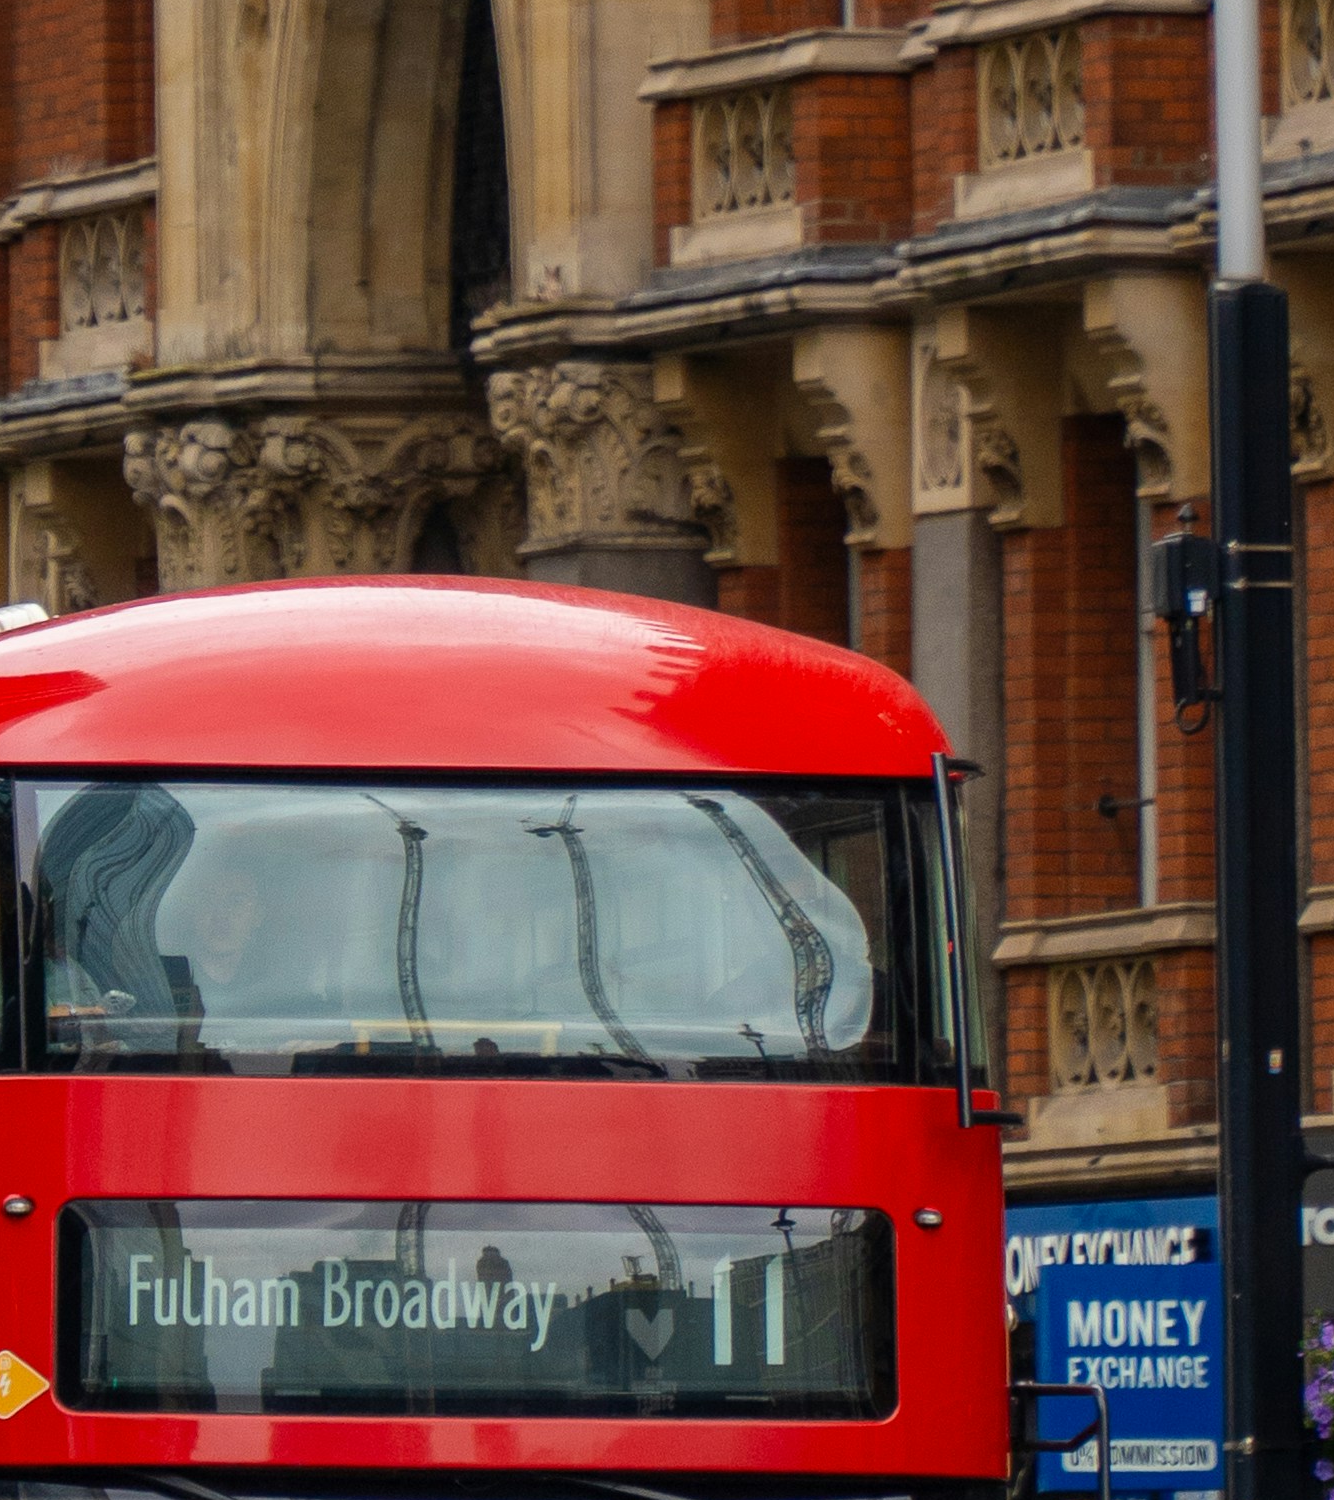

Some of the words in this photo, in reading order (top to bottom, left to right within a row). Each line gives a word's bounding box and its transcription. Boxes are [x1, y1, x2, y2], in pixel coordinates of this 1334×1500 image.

[1005, 1233, 1069, 1296] ONEY
[128, 1253, 300, 1328] Fulham
[322, 1255, 557, 1352] Broadway
[713, 1252, 786, 1367] 11
[1067, 1300, 1207, 1348] MONEY
[1067, 1355, 1210, 1389] EXCHANGE
[1110, 1444, 1210, 1466] OMMISSION
